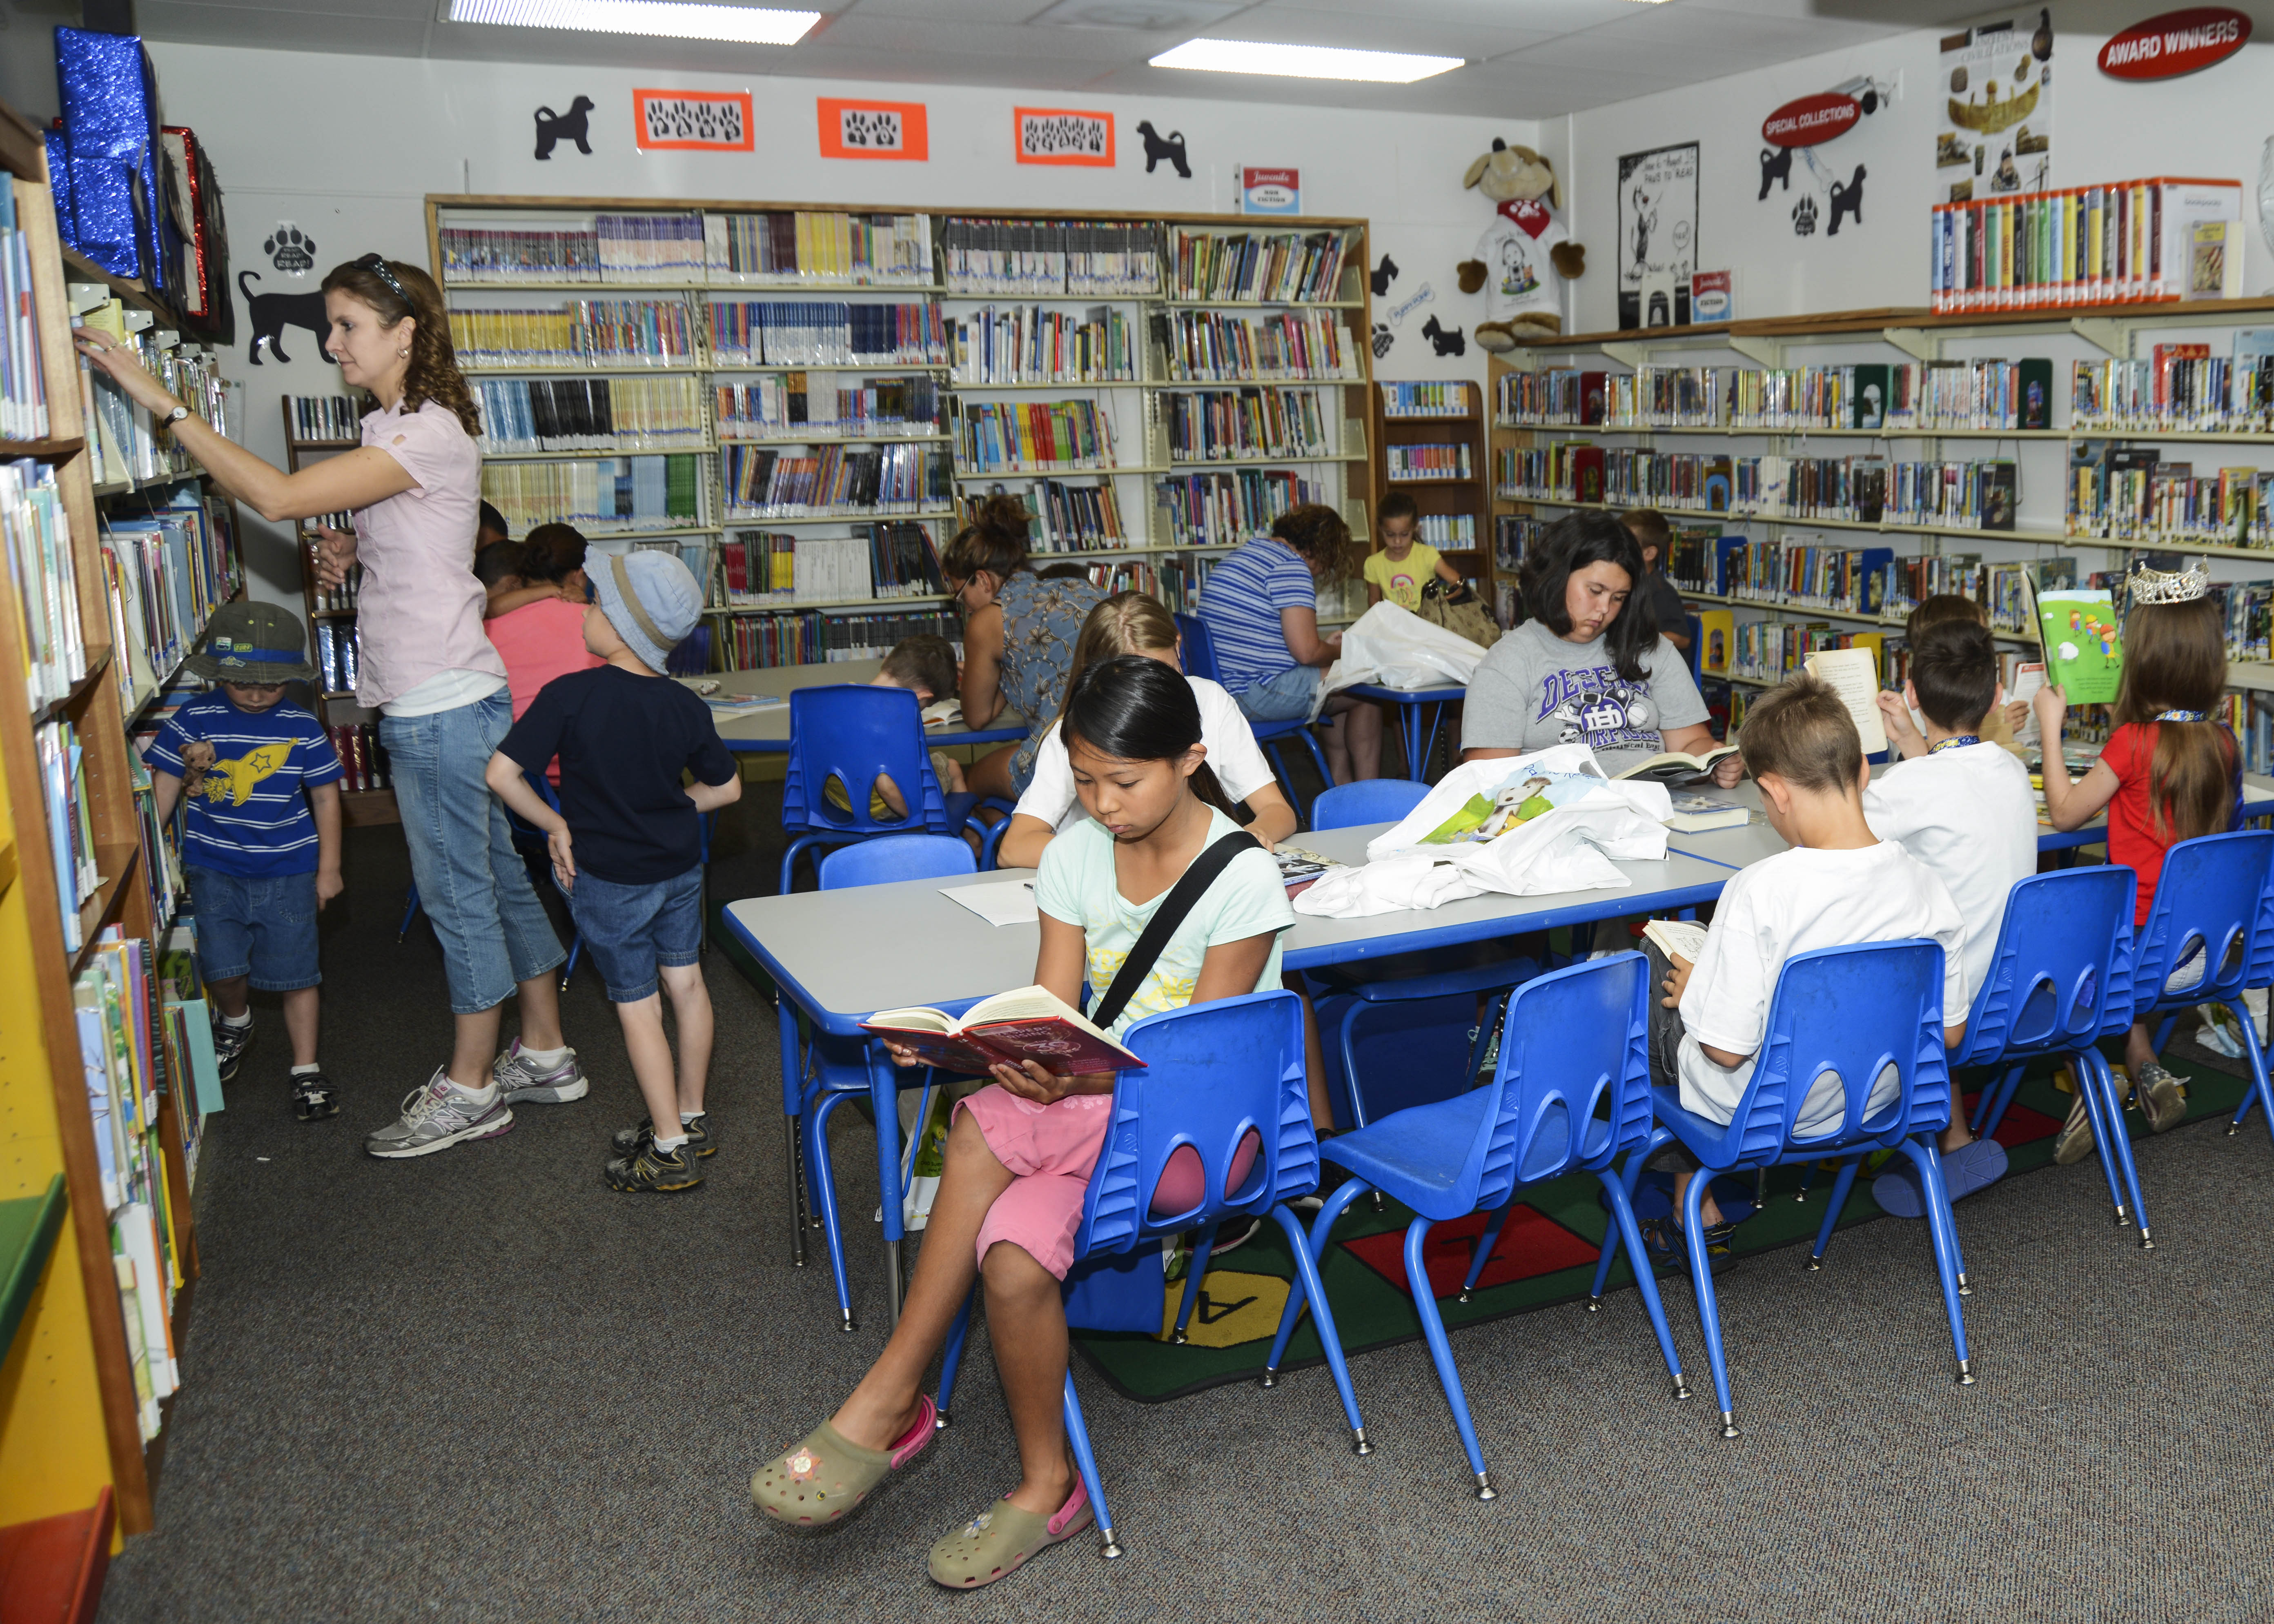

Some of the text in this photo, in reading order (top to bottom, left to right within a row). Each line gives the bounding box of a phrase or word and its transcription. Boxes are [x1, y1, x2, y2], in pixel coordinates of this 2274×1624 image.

[2106, 18, 2239, 68] AWARD WINNERS
[1766, 103, 1855, 136] SPECIAL COLLECTIONS
[1254, 170, 1290, 184] Juvenile
[1007, 1030, 1052, 1039] RISING
[1035, 1041, 1069, 1052] 39
[1198, 1291, 1258, 1324] A
